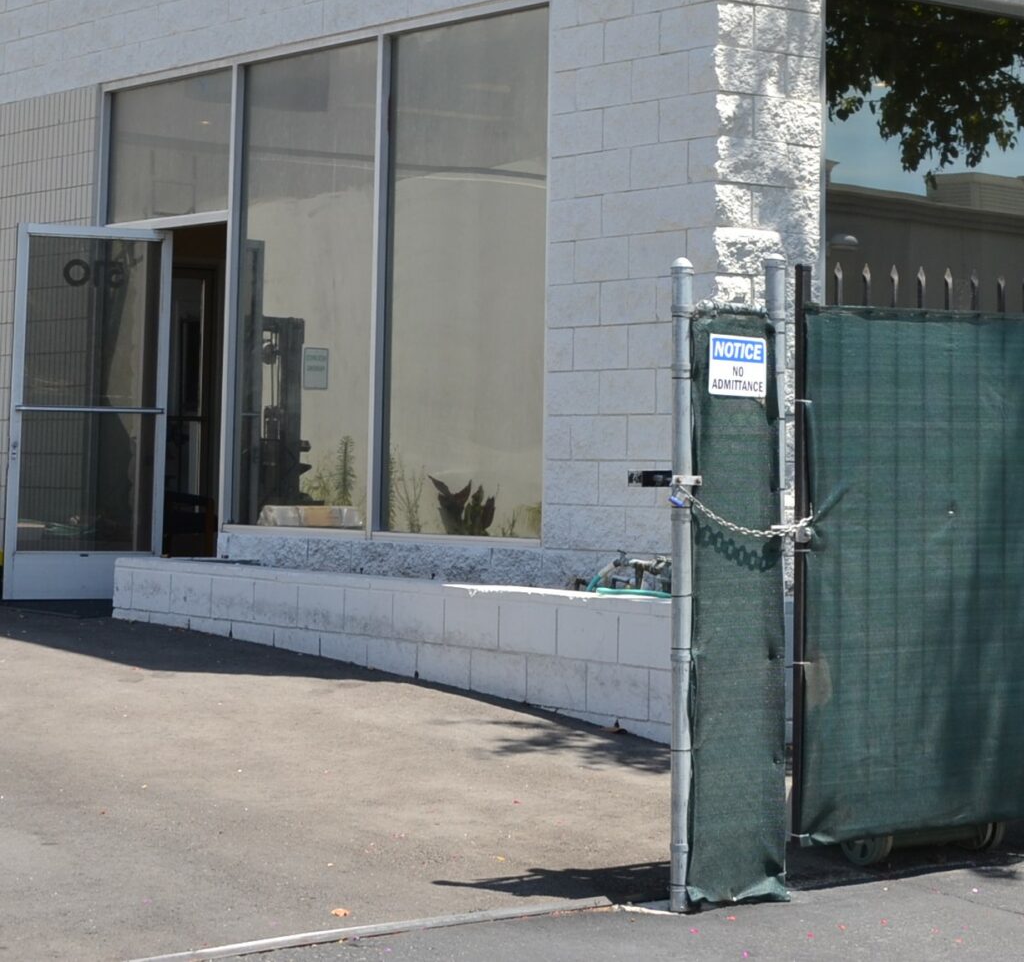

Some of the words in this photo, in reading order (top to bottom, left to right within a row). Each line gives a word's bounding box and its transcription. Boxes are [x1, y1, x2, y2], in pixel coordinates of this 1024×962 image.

[714, 340, 763, 360] NOTICE
[732, 366, 744, 378] NO
[711, 378, 764, 393] ADMITTANCE
